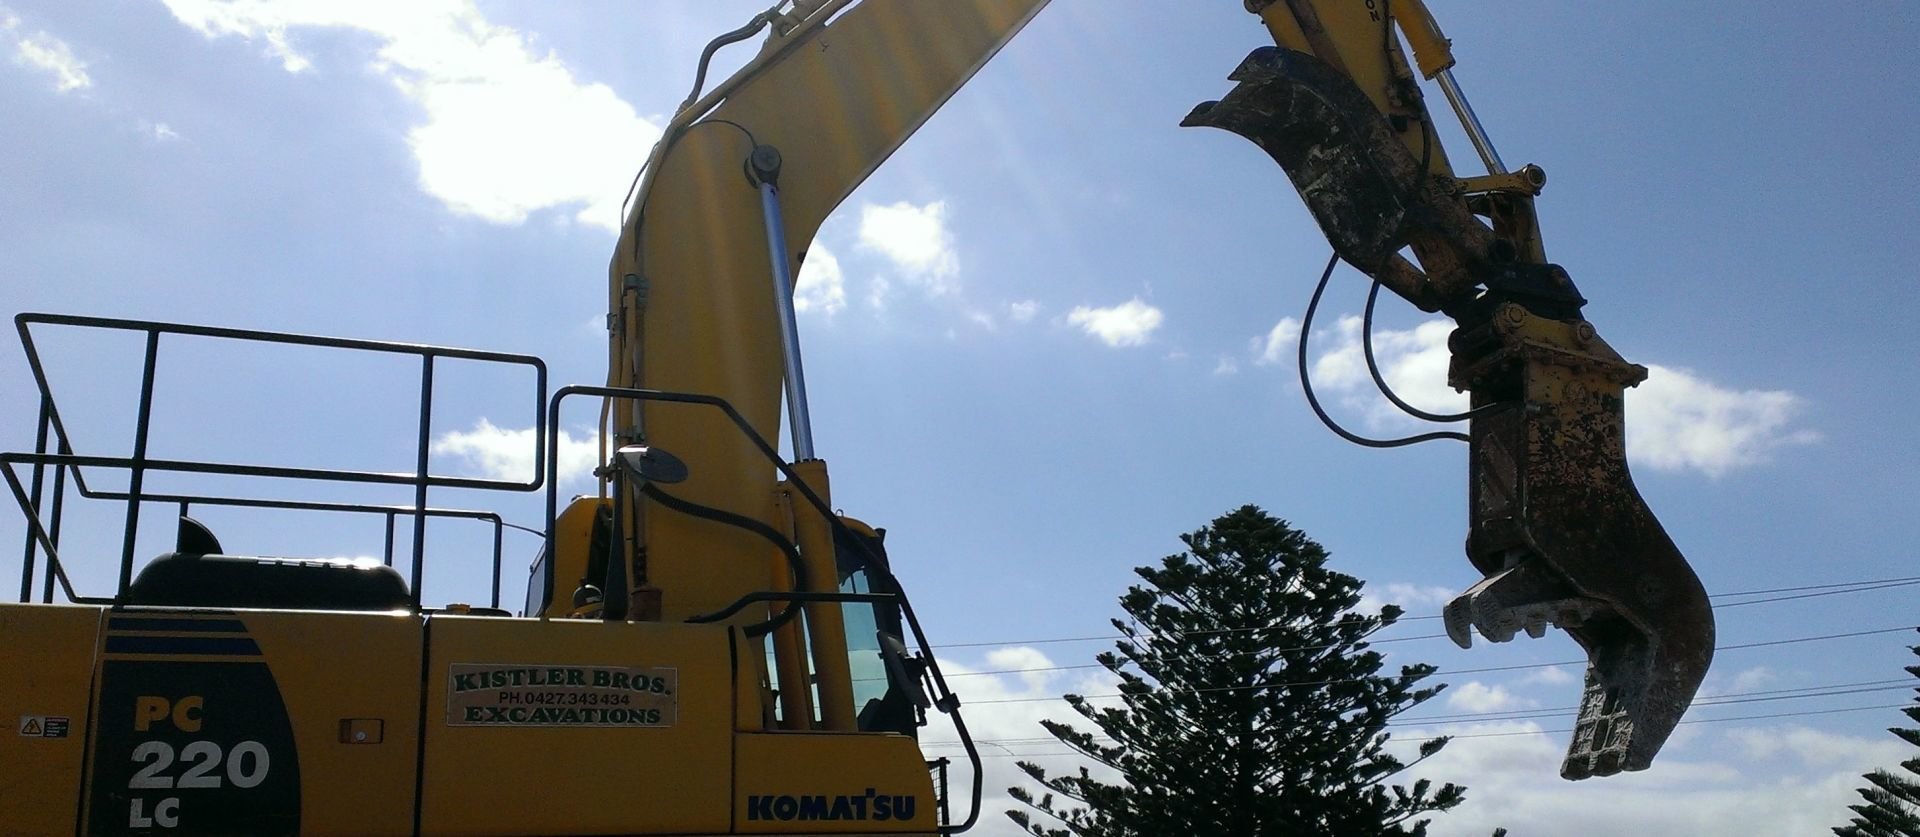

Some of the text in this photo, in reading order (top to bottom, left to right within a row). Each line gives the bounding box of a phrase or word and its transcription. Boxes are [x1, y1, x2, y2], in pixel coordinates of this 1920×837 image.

[455, 669, 672, 695] KISTLER BROS.
[134, 696, 203, 732] PC
[465, 706, 660, 724] EXCAVATIONS
[128, 740, 270, 788] 220
[129, 797, 179, 828] LC
[748, 788, 915, 820] KOMATSU
